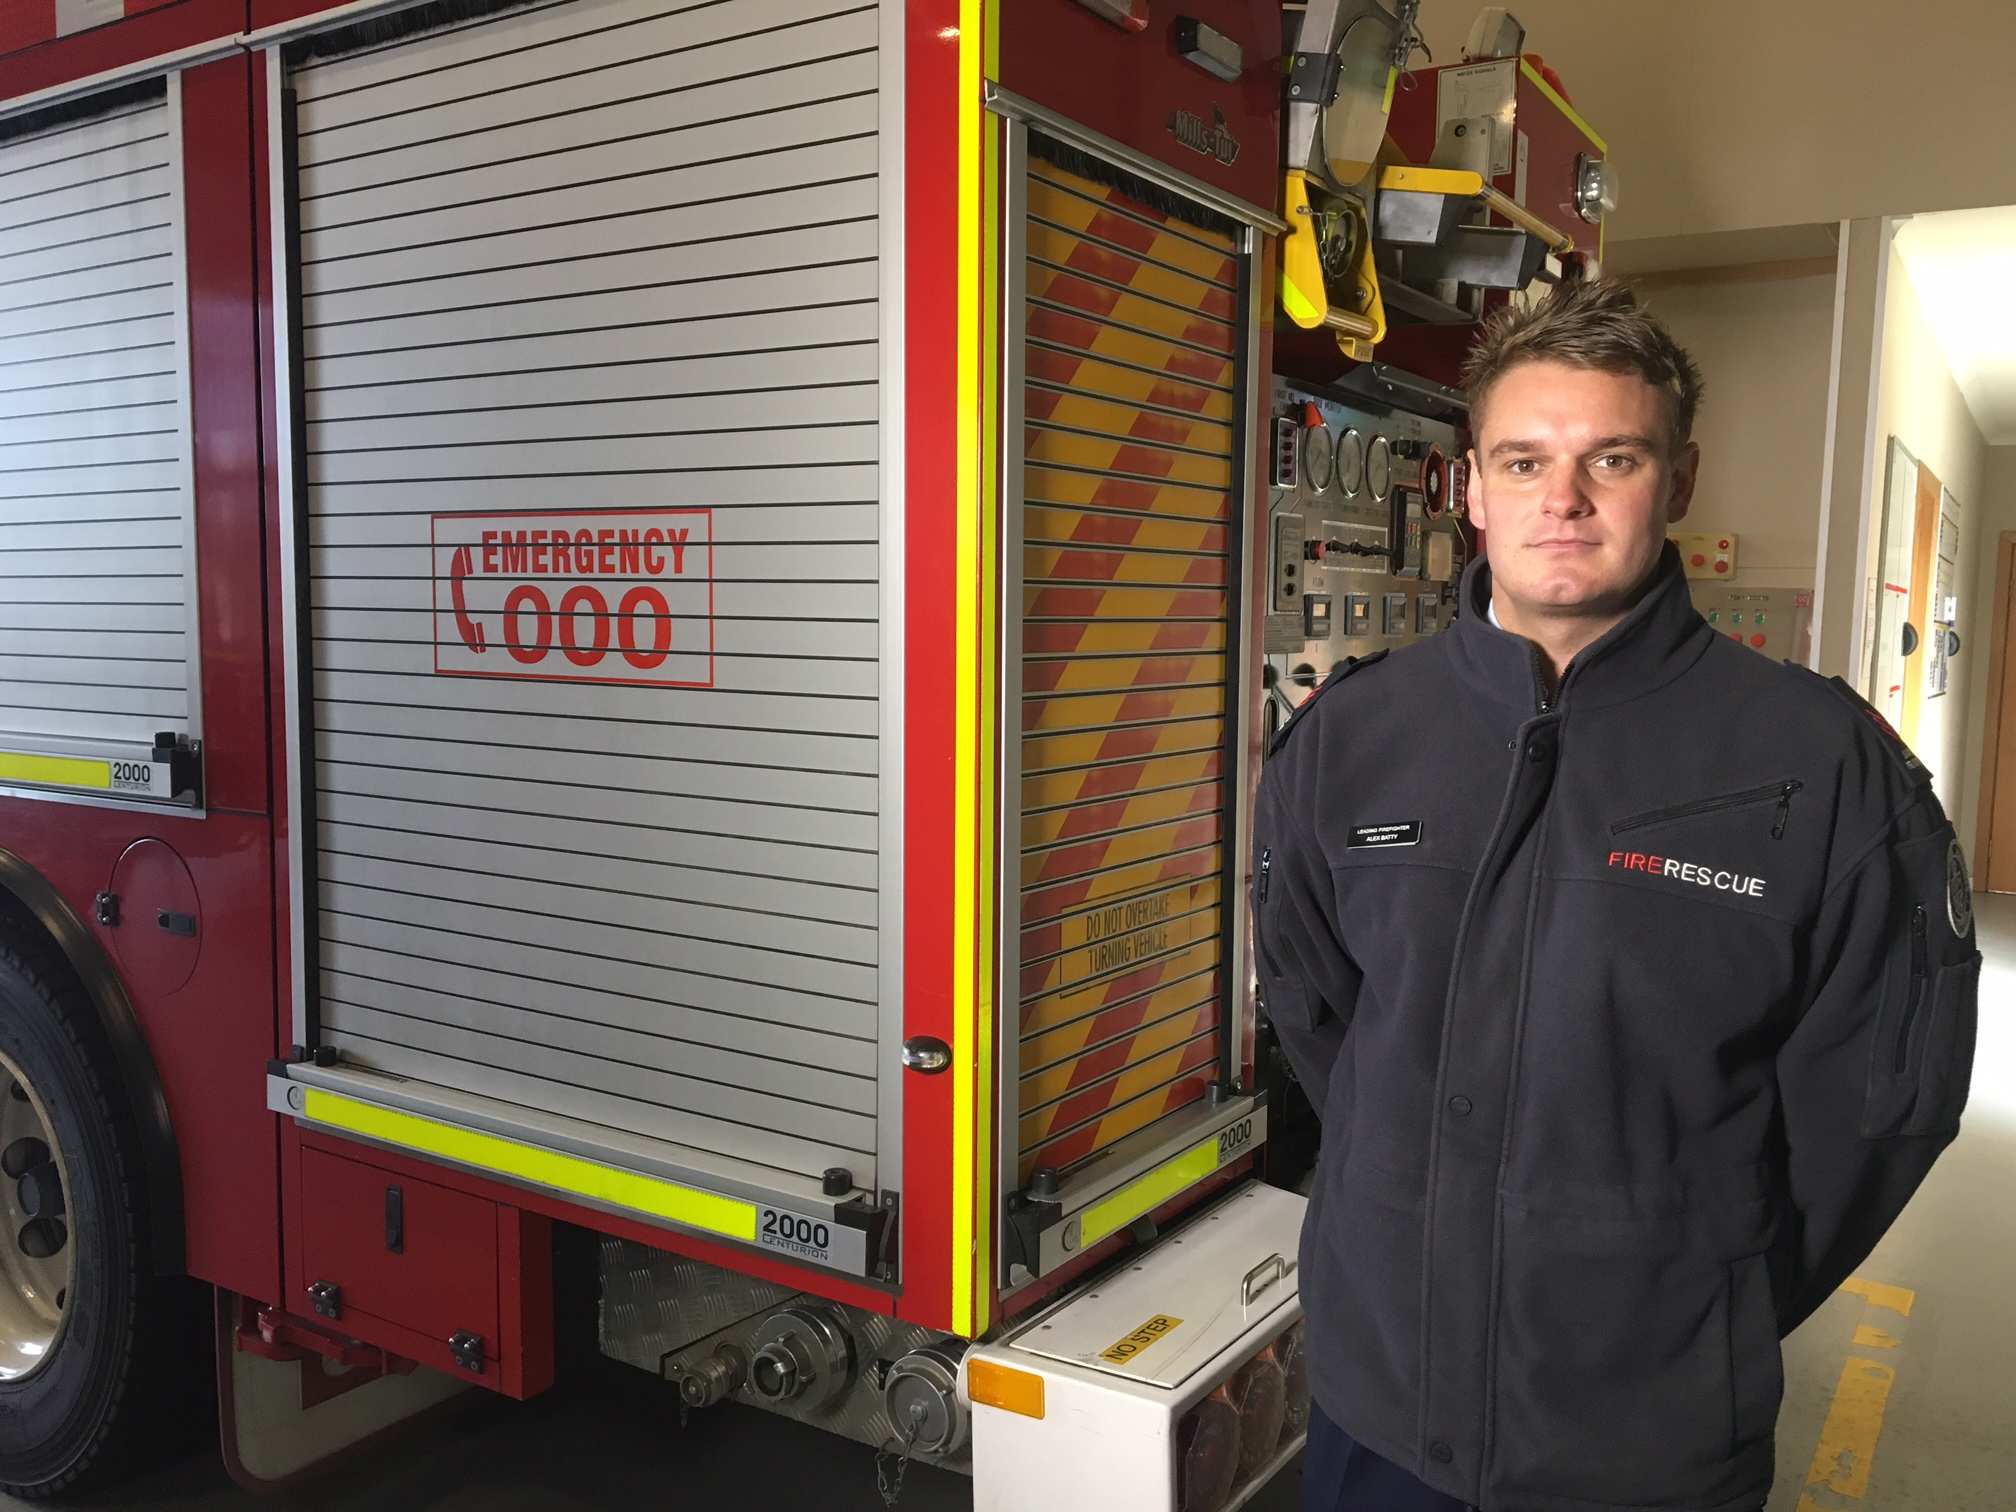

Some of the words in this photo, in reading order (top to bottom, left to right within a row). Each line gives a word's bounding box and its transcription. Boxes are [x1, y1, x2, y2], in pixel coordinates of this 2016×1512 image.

[481, 527, 690, 575] EMERGENCY
[503, 584, 672, 670] 000
[113, 762, 151, 783] 2000
[1380, 833, 1398, 841] BATTY
[1086, 913, 1101, 942] DO
[1104, 906, 1122, 936] NOT
[1125, 893, 1170, 928] OVERTAKE
[1087, 937, 1131, 974] TURNING
[1133, 926, 1168, 959] VEHICLE
[1220, 1118, 1252, 1154] 2000
[762, 1210, 829, 1249] 2000
[762, 1232, 829, 1261] CENTURION
[1105, 1343, 1137, 1360] NO
[1130, 1318, 1171, 1344] STEP
